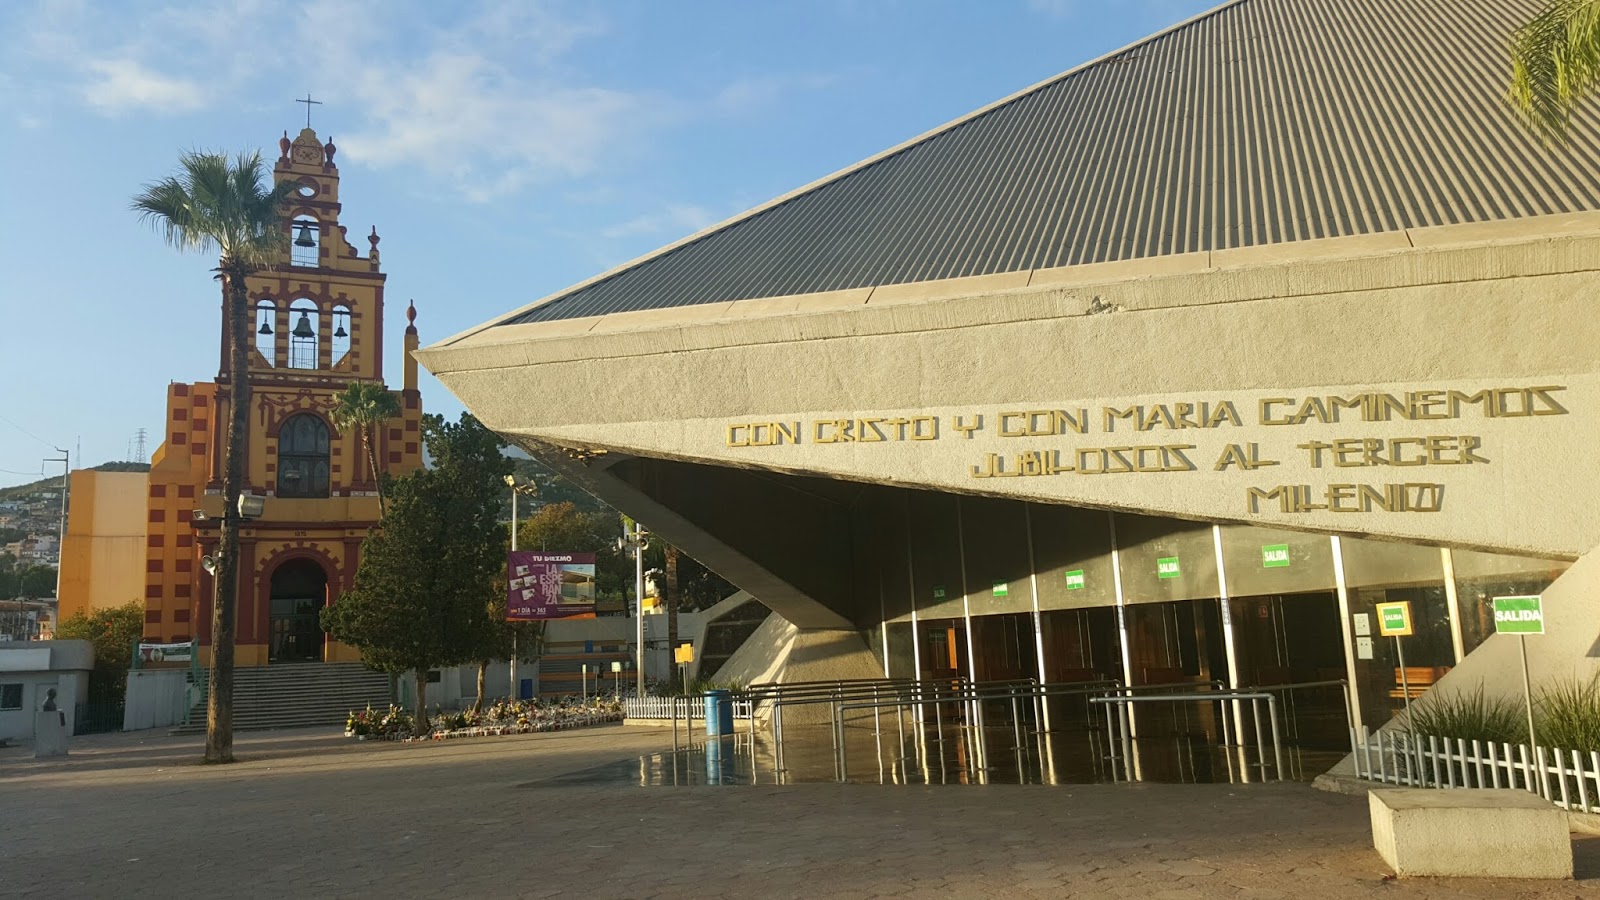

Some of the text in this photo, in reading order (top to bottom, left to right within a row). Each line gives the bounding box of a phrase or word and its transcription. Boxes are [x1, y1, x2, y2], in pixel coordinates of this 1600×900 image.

[726, 385, 1569, 447] CON CRISTO Y CON MARIA CAMINEMOS
[969, 435, 1490, 478] JUBILOSOS AL TERCER
[1246, 482, 1442, 513] MILENIO
[1264, 550, 1288, 562] SALIDA
[546, 564, 558, 575] LA
[1159, 562, 1178, 573] SALIDA
[540, 574, 563, 585] ESPE
[542, 584, 561, 595] RAN
[545, 594, 558, 605] ZA
[1384, 613, 1403, 621] SALIDA
[1496, 609, 1541, 622] SALIDA
